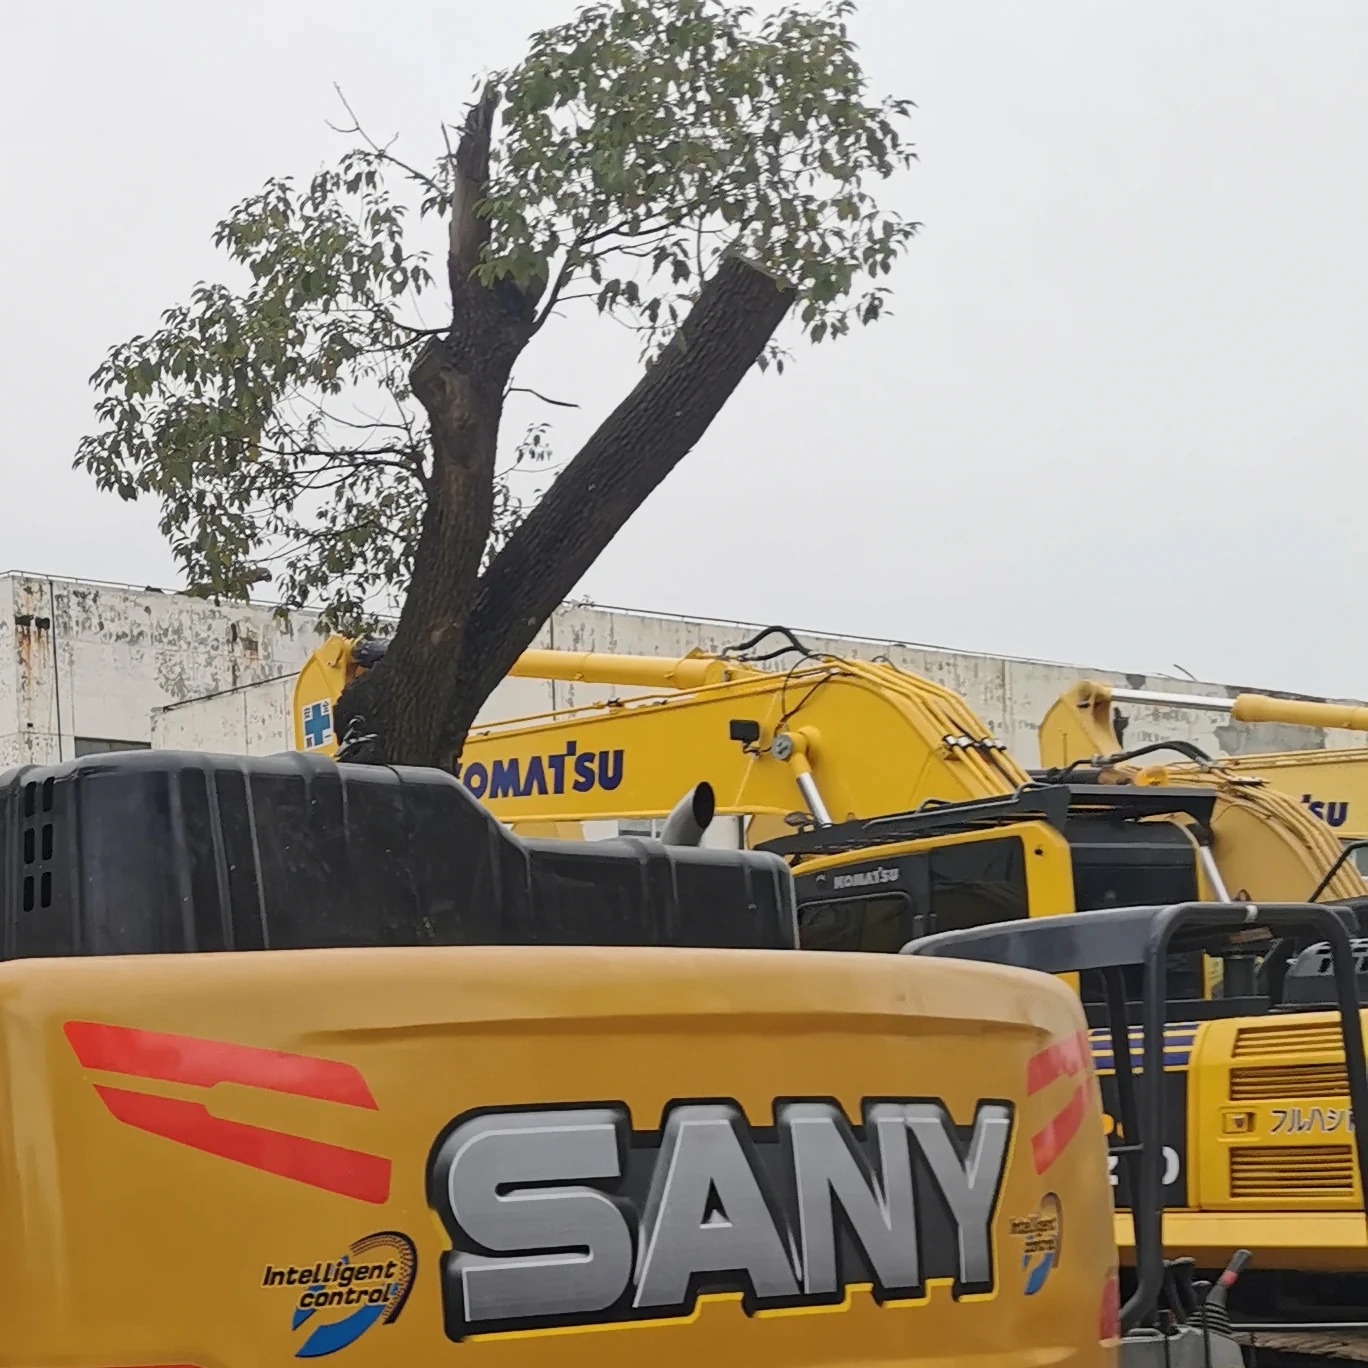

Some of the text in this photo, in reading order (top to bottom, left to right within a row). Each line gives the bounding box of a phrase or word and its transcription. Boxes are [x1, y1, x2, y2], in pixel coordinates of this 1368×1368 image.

[457, 740, 624, 799] OMATSU
[429, 1099, 1013, 1332] SANY
[262, 1260, 398, 1287] Intelligent
[299, 1283, 392, 1308] control
